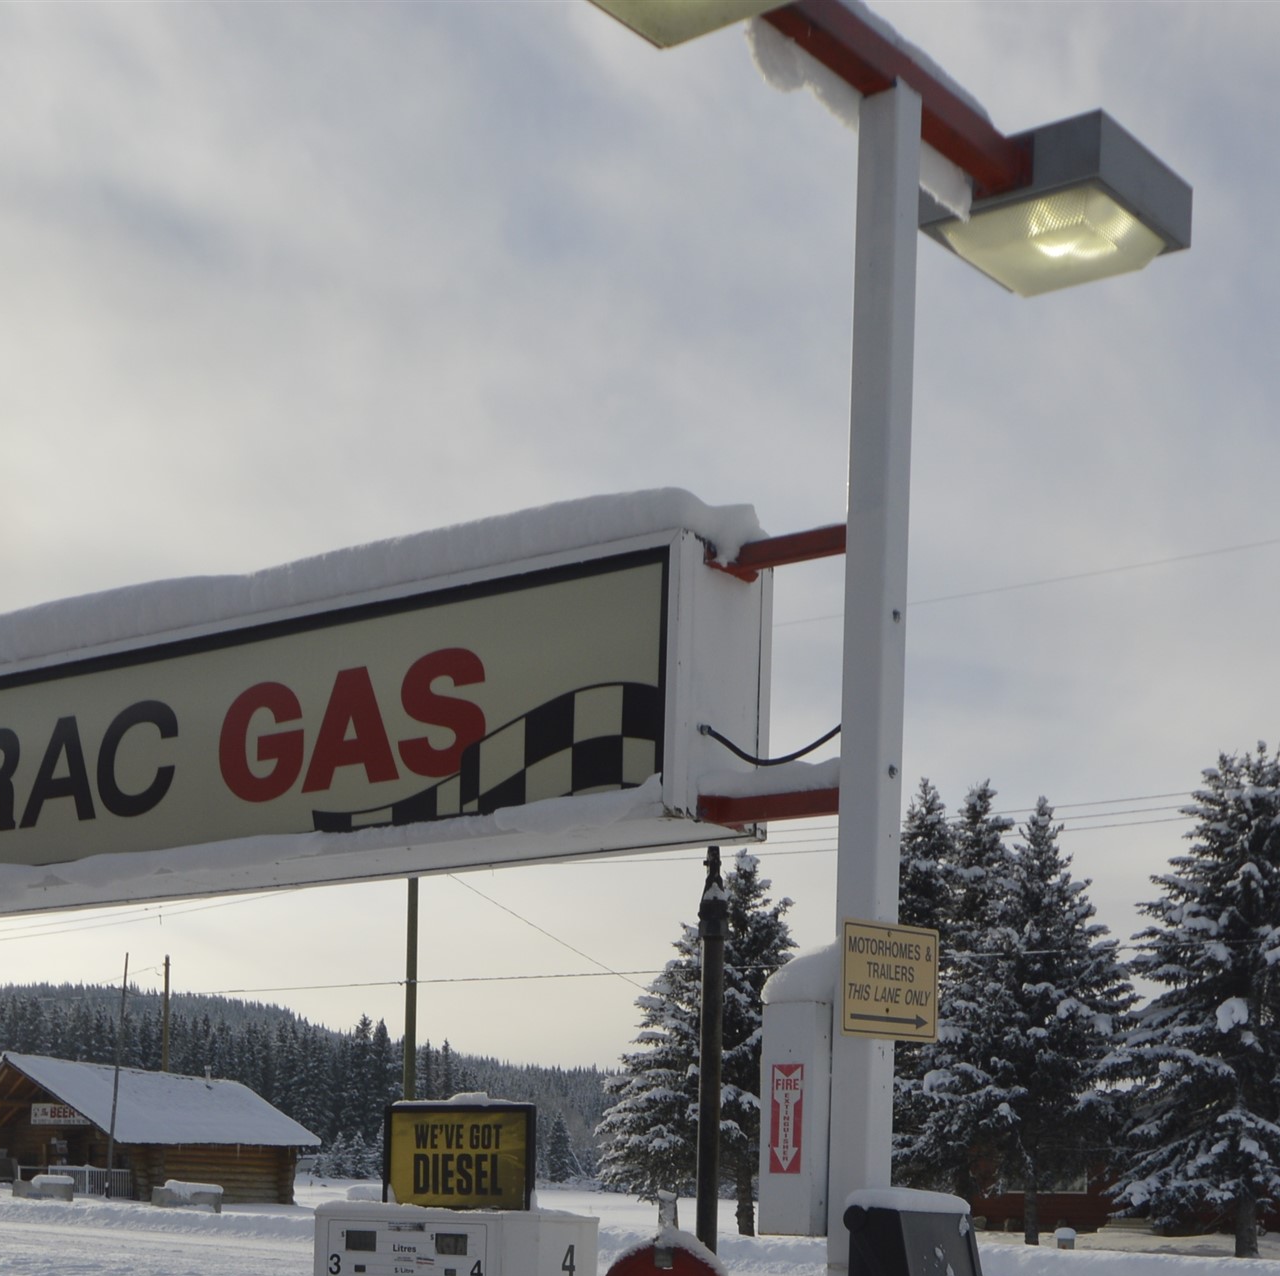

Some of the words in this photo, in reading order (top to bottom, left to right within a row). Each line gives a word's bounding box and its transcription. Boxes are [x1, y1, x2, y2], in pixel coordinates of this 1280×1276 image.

[219, 648, 487, 803] GAS
[848, 936, 921, 961] MOTORHOMES
[925, 946, 932, 962] &
[867, 961, 915, 983] TRAILERS
[848, 983, 871, 1001] THIS
[874, 986, 901, 1004] LANE
[904, 989, 931, 1007] ONLY
[775, 1078, 800, 1091] FIRE
[50, 1105, 76, 1119] BEER
[414, 1124, 464, 1149] WE'VE
[470, 1124, 502, 1149] GOT
[782, 1093, 790, 1162] EXTINGUISHER
[413, 1153, 503, 1196] DIESEL
[392, 1244, 417, 1254] Litres
[328, 1253, 341, 1275] 3
